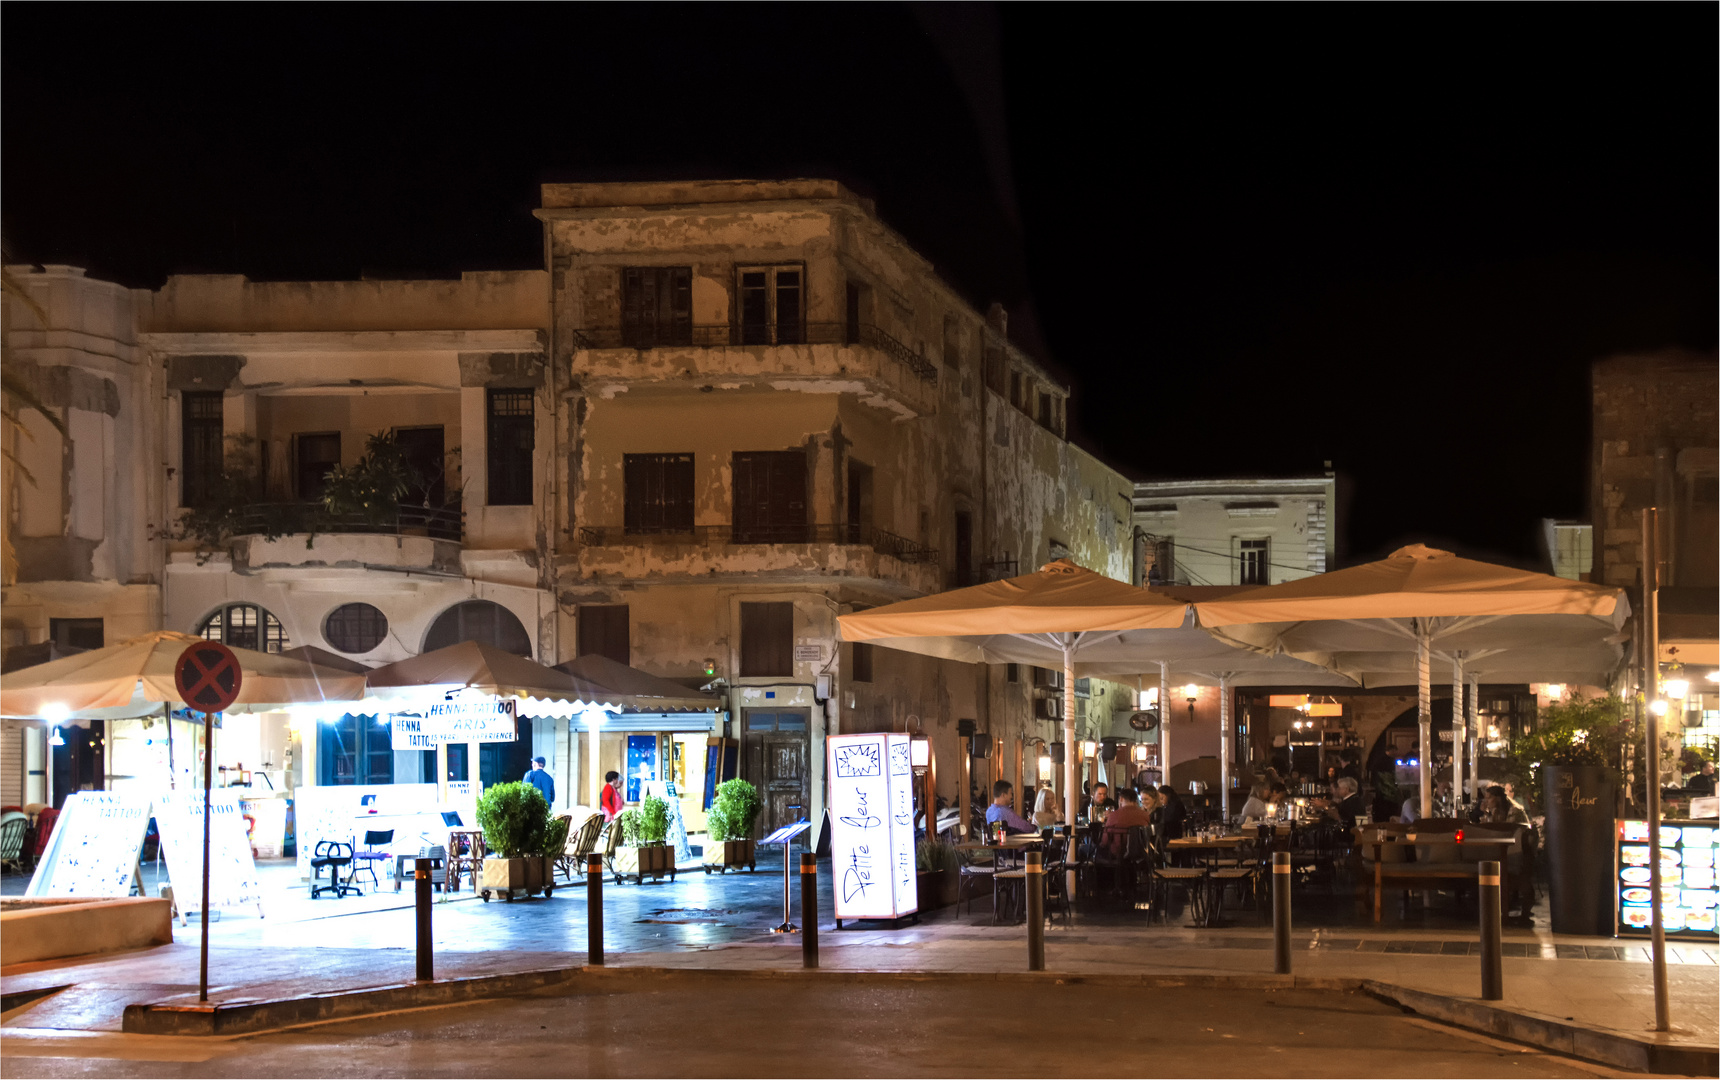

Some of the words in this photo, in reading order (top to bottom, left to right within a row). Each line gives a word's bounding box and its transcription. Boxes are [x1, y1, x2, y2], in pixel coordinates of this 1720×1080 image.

[430, 704, 467, 716] HENNA
[474, 701, 512, 714] TATTOO
[396, 720, 421, 732] HENNA
[408, 734, 434, 747] TATTO
[188, 804, 234, 815] TATOO
